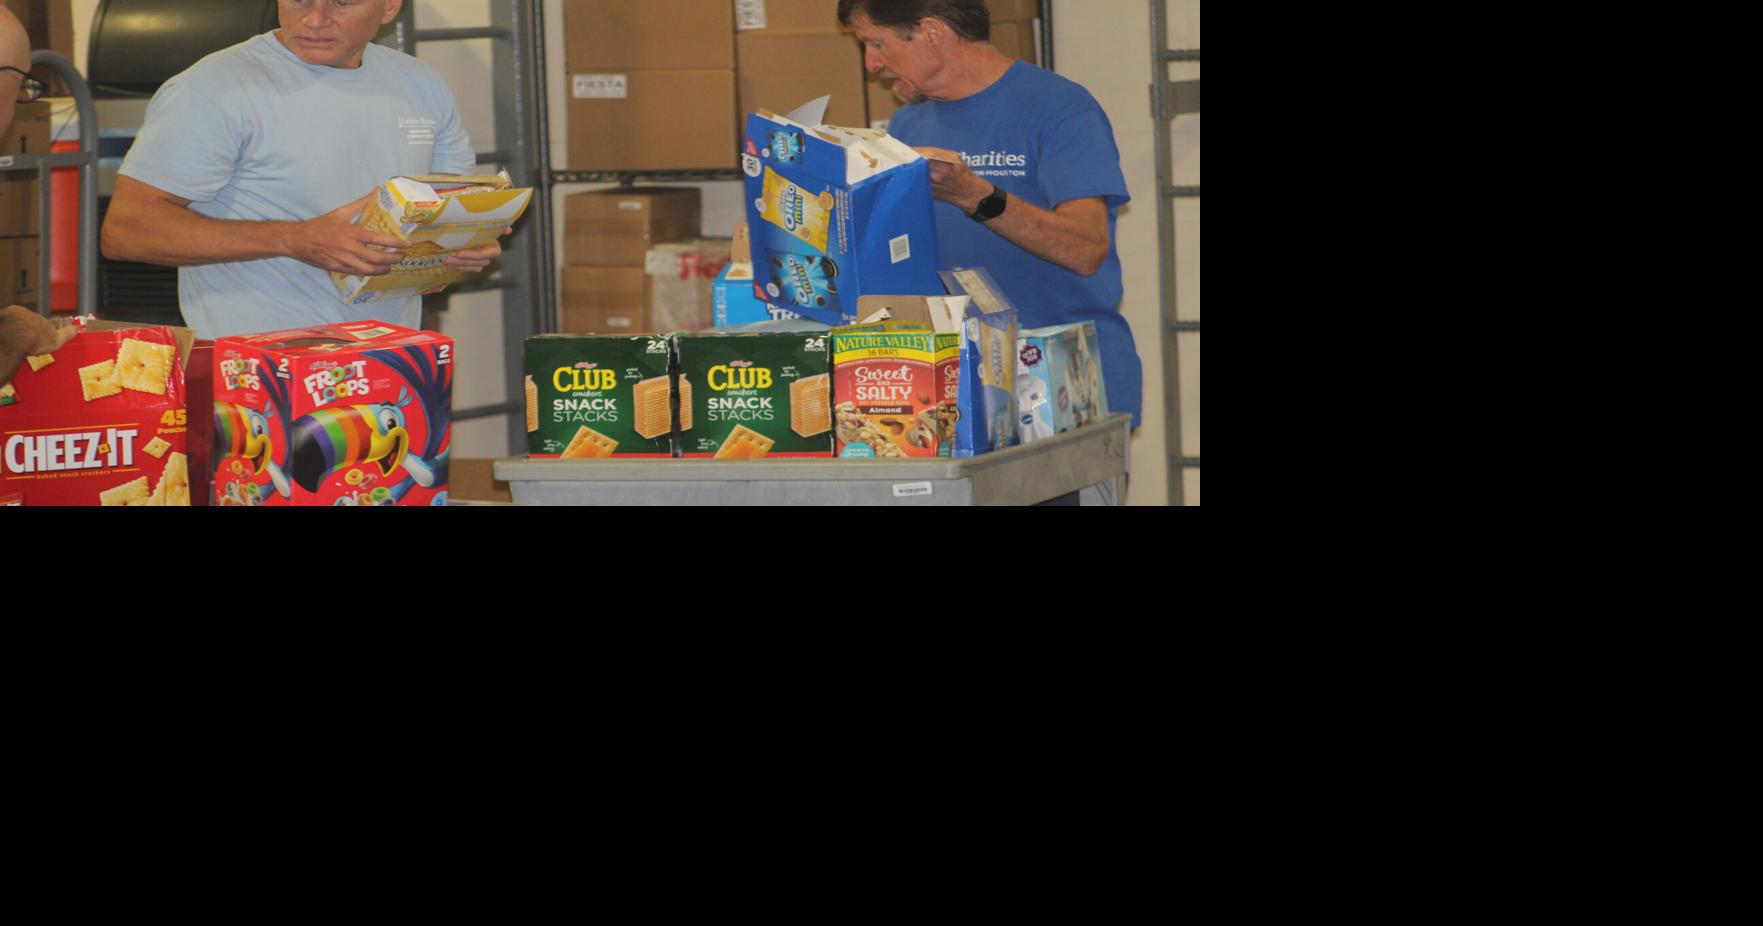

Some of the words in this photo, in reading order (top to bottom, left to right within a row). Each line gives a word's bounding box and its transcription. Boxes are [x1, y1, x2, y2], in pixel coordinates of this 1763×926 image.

[746, 158, 753, 172] 30
[958, 151, 1025, 167] harities
[784, 184, 797, 231] OREO
[794, 194, 803, 225] mini
[439, 344, 449, 358] 2
[647, 340, 666, 350] 24
[805, 338, 825, 348] 24
[836, 336, 885, 353] NATURE
[885, 335, 929, 352] VALLEY
[868, 348, 877, 356] 36
[878, 347, 900, 356] BARS
[219, 358, 260, 377] FROOT
[278, 358, 289, 372] 2
[303, 360, 367, 394] FROOT
[552, 366, 617, 392] CLUB
[707, 364, 773, 391] CLUB
[854, 365, 913, 383] Sweet
[225, 374, 260, 391] LOOPS
[312, 377, 370, 407] LOOPS
[856, 386, 913, 400] SALTY
[553, 398, 618, 411] SNACK
[707, 397, 774, 409] SNACK
[160, 408, 187, 426] 45
[553, 410, 619, 423] STACKS
[707, 409, 775, 421] STACKS
